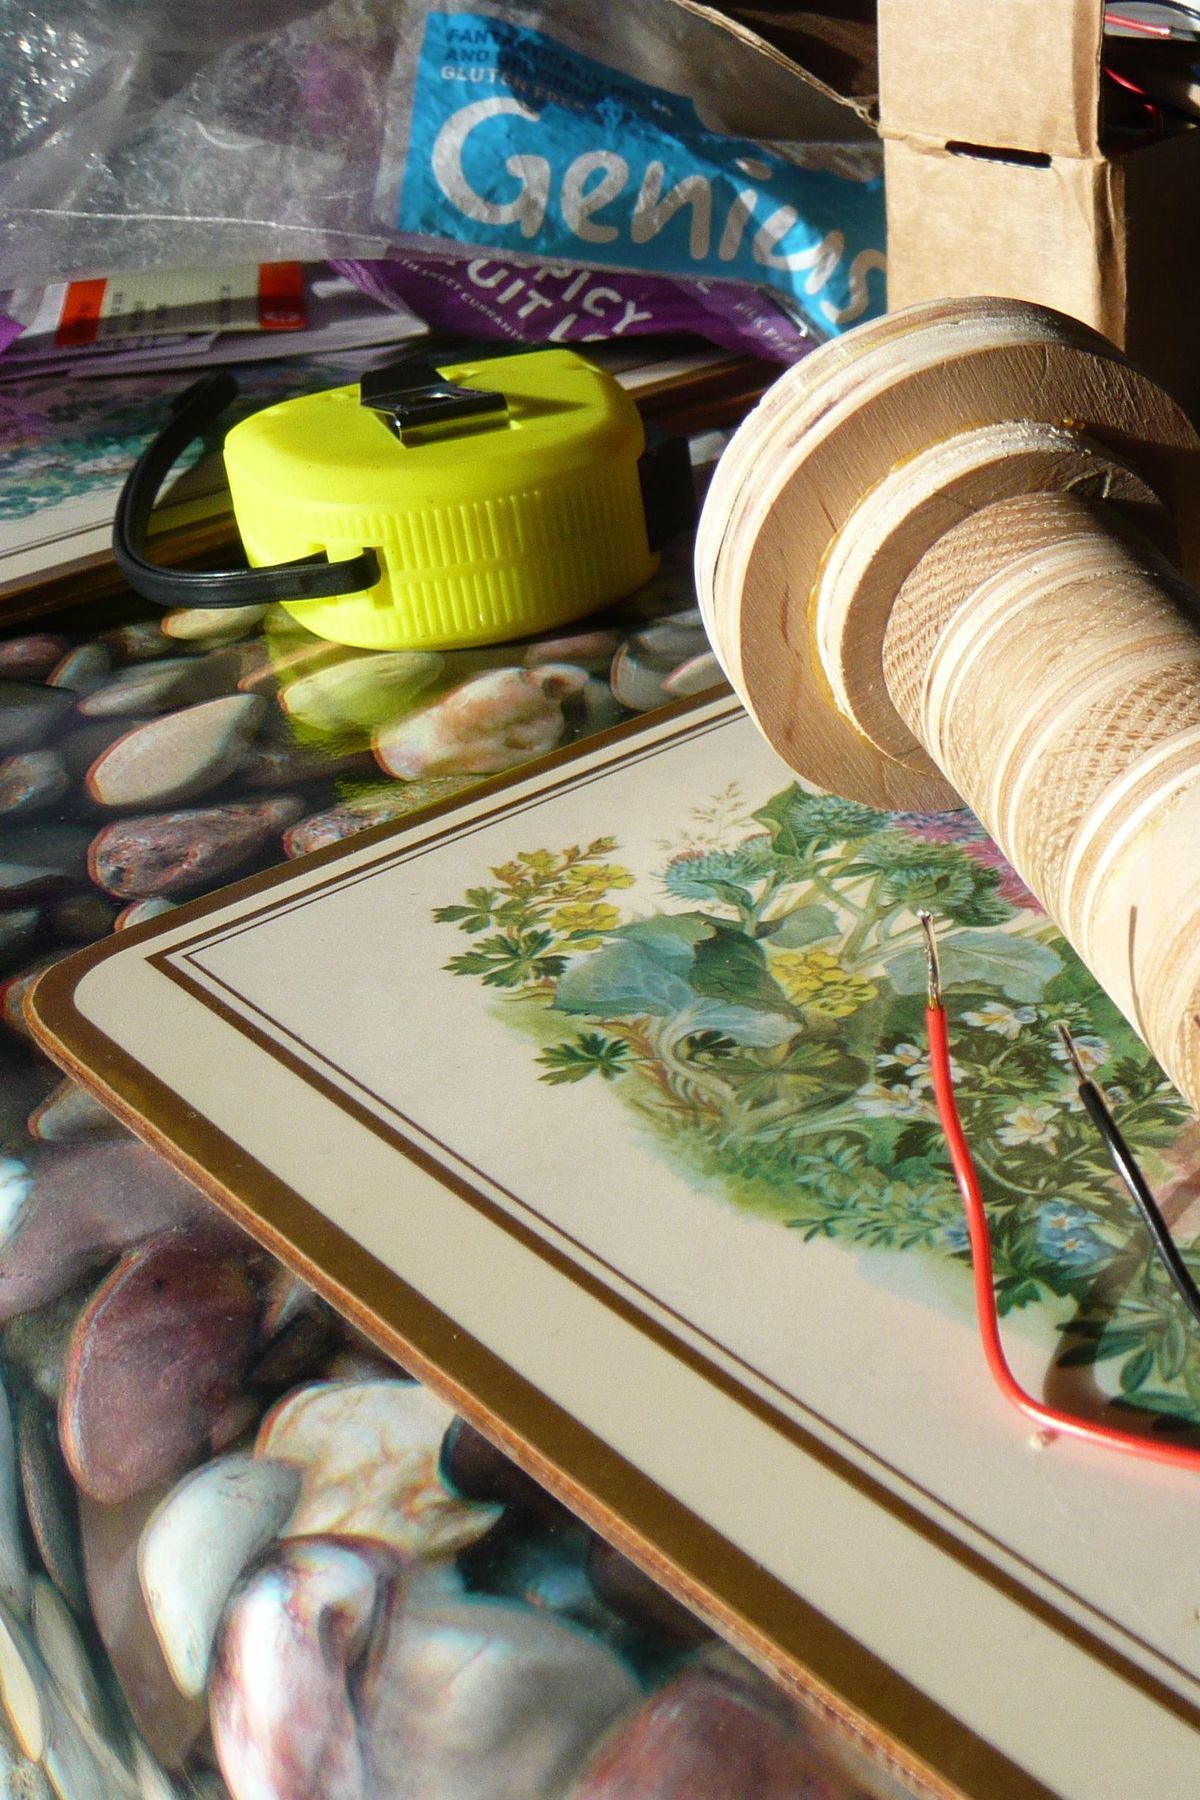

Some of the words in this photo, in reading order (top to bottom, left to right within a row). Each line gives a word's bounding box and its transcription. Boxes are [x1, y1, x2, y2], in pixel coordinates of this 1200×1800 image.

[441, 65, 528, 94] GLUTEN
[445, 49, 490, 63] AND
[432, 96, 888, 324] Genius
[448, 258, 553, 320] UIT
[512, 262, 653, 335] PICY
